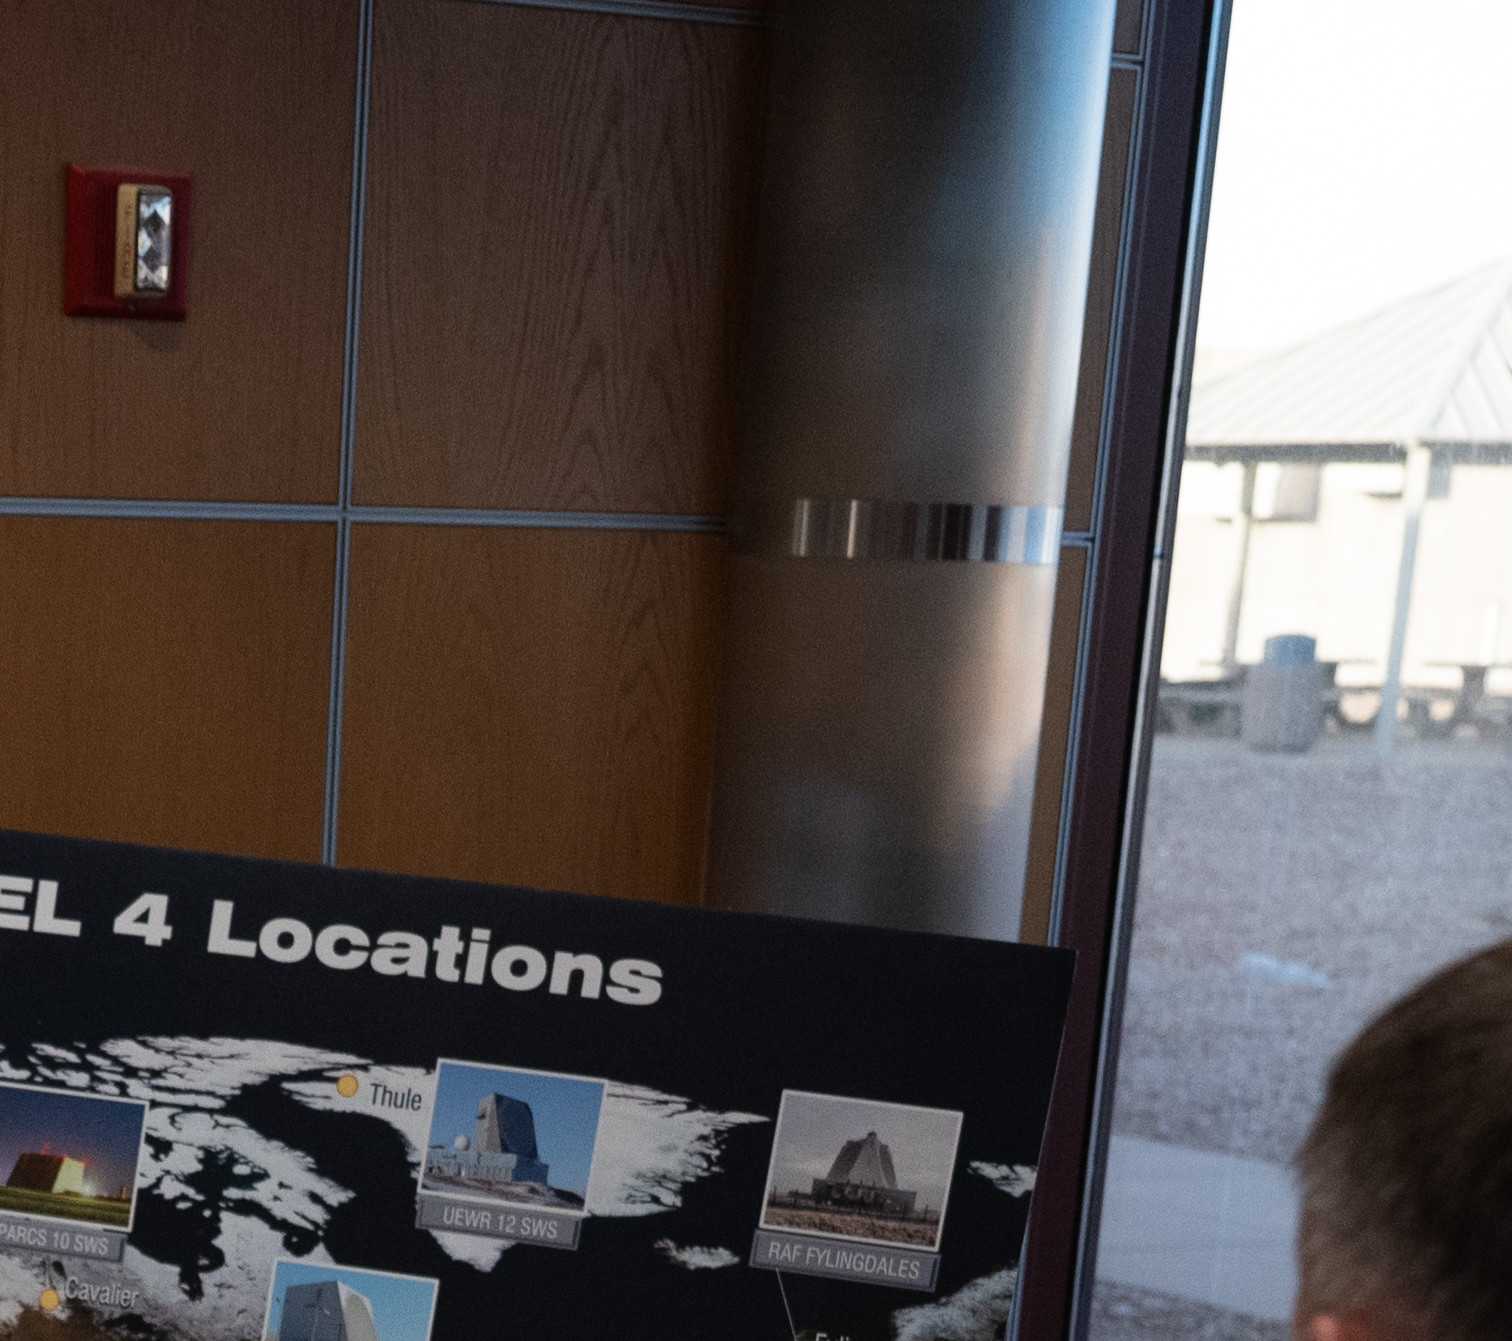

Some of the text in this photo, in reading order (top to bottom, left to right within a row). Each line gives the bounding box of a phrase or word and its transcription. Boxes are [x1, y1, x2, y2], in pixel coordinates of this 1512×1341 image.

[112, 892, 174, 946] 4
[206, 899, 664, 1006] Locations
[369, 1082, 422, 1112] Thule
[443, 1205, 558, 1239] UEWR 12 SWS
[51, 1228, 70, 1250] 10
[73, 1231, 109, 1256] SWS
[768, 1241, 920, 1279] RAF FYLINGDALES
[65, 1276, 140, 1309] Cavalier
